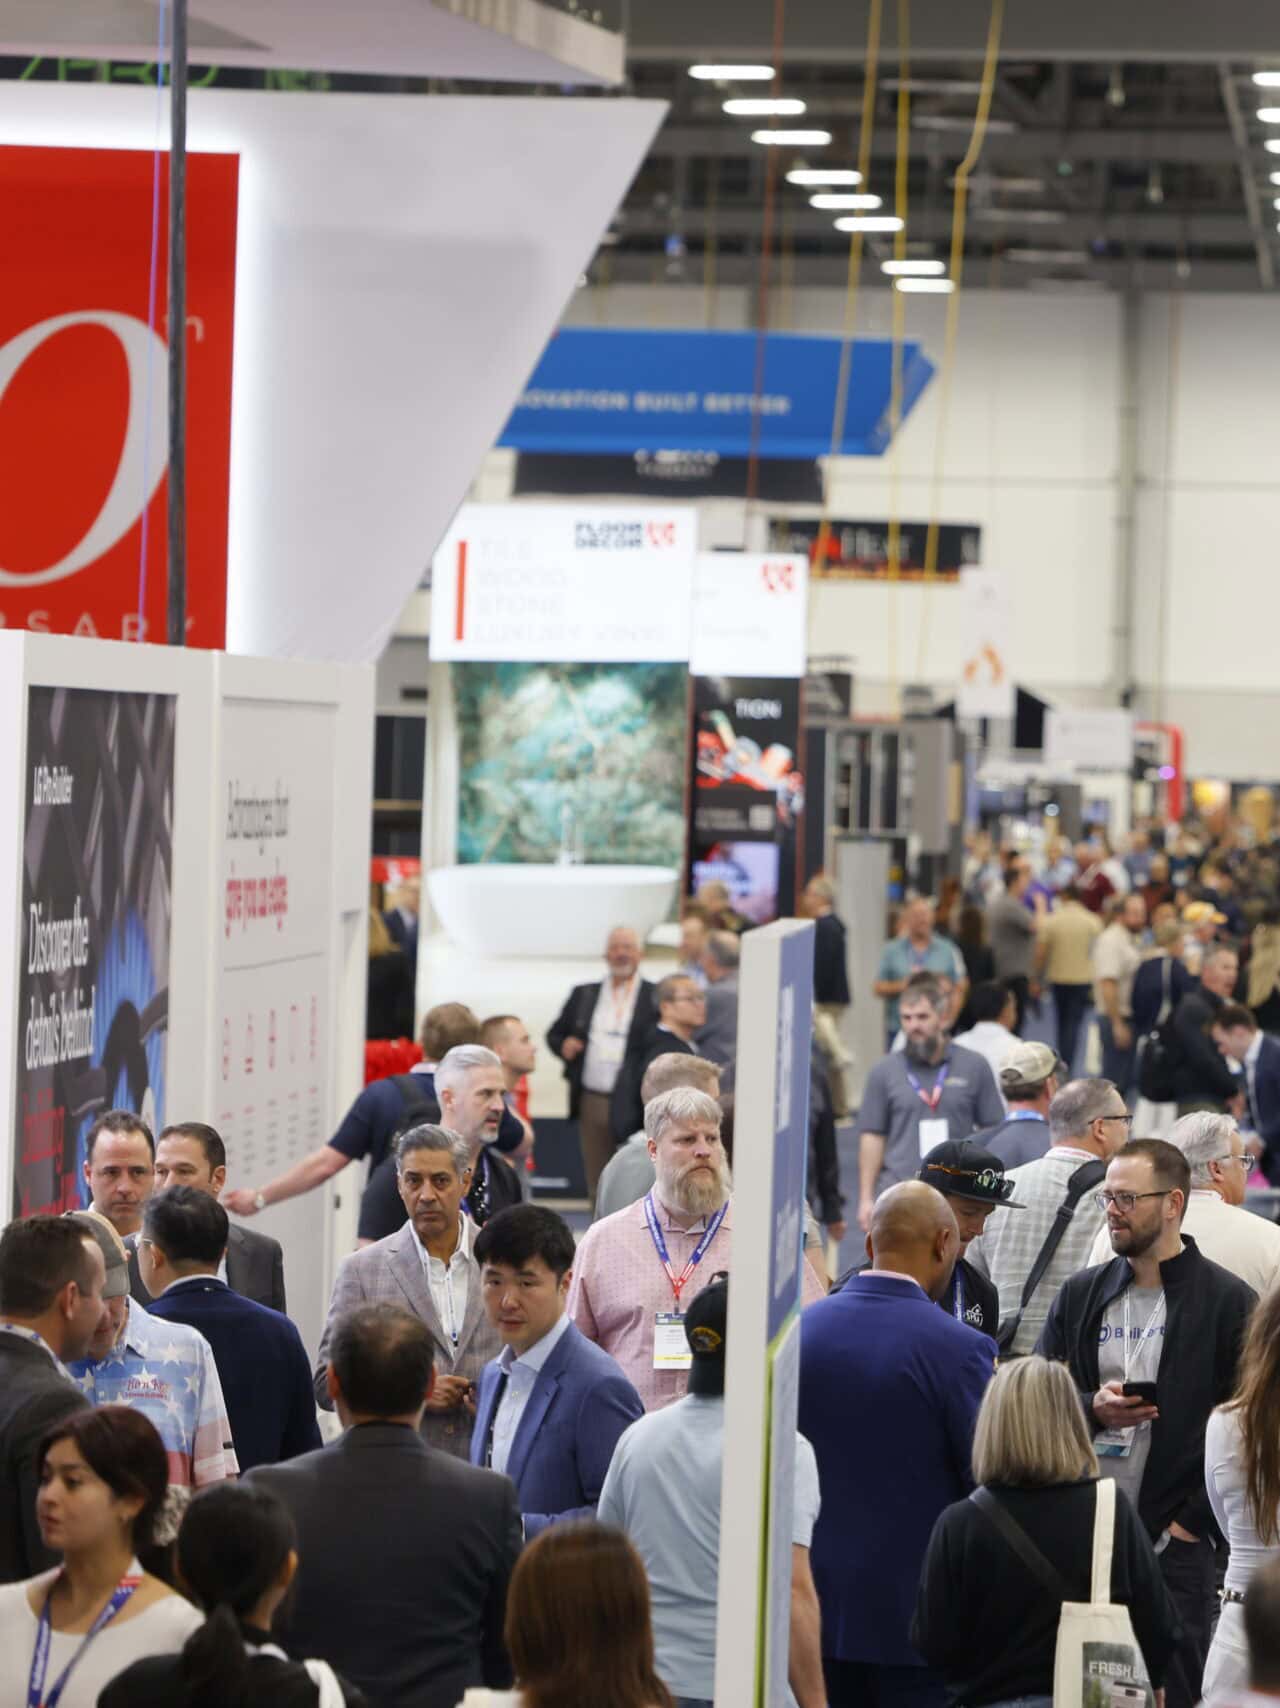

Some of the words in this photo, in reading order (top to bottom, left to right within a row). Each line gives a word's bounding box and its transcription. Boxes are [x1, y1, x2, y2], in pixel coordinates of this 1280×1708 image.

[28, 902, 72, 974] Discover
[73, 895, 89, 966] the
[26, 991, 60, 1070] details
[60, 985, 96, 1062] behind
[1088, 1661, 1131, 1679] FRESH
